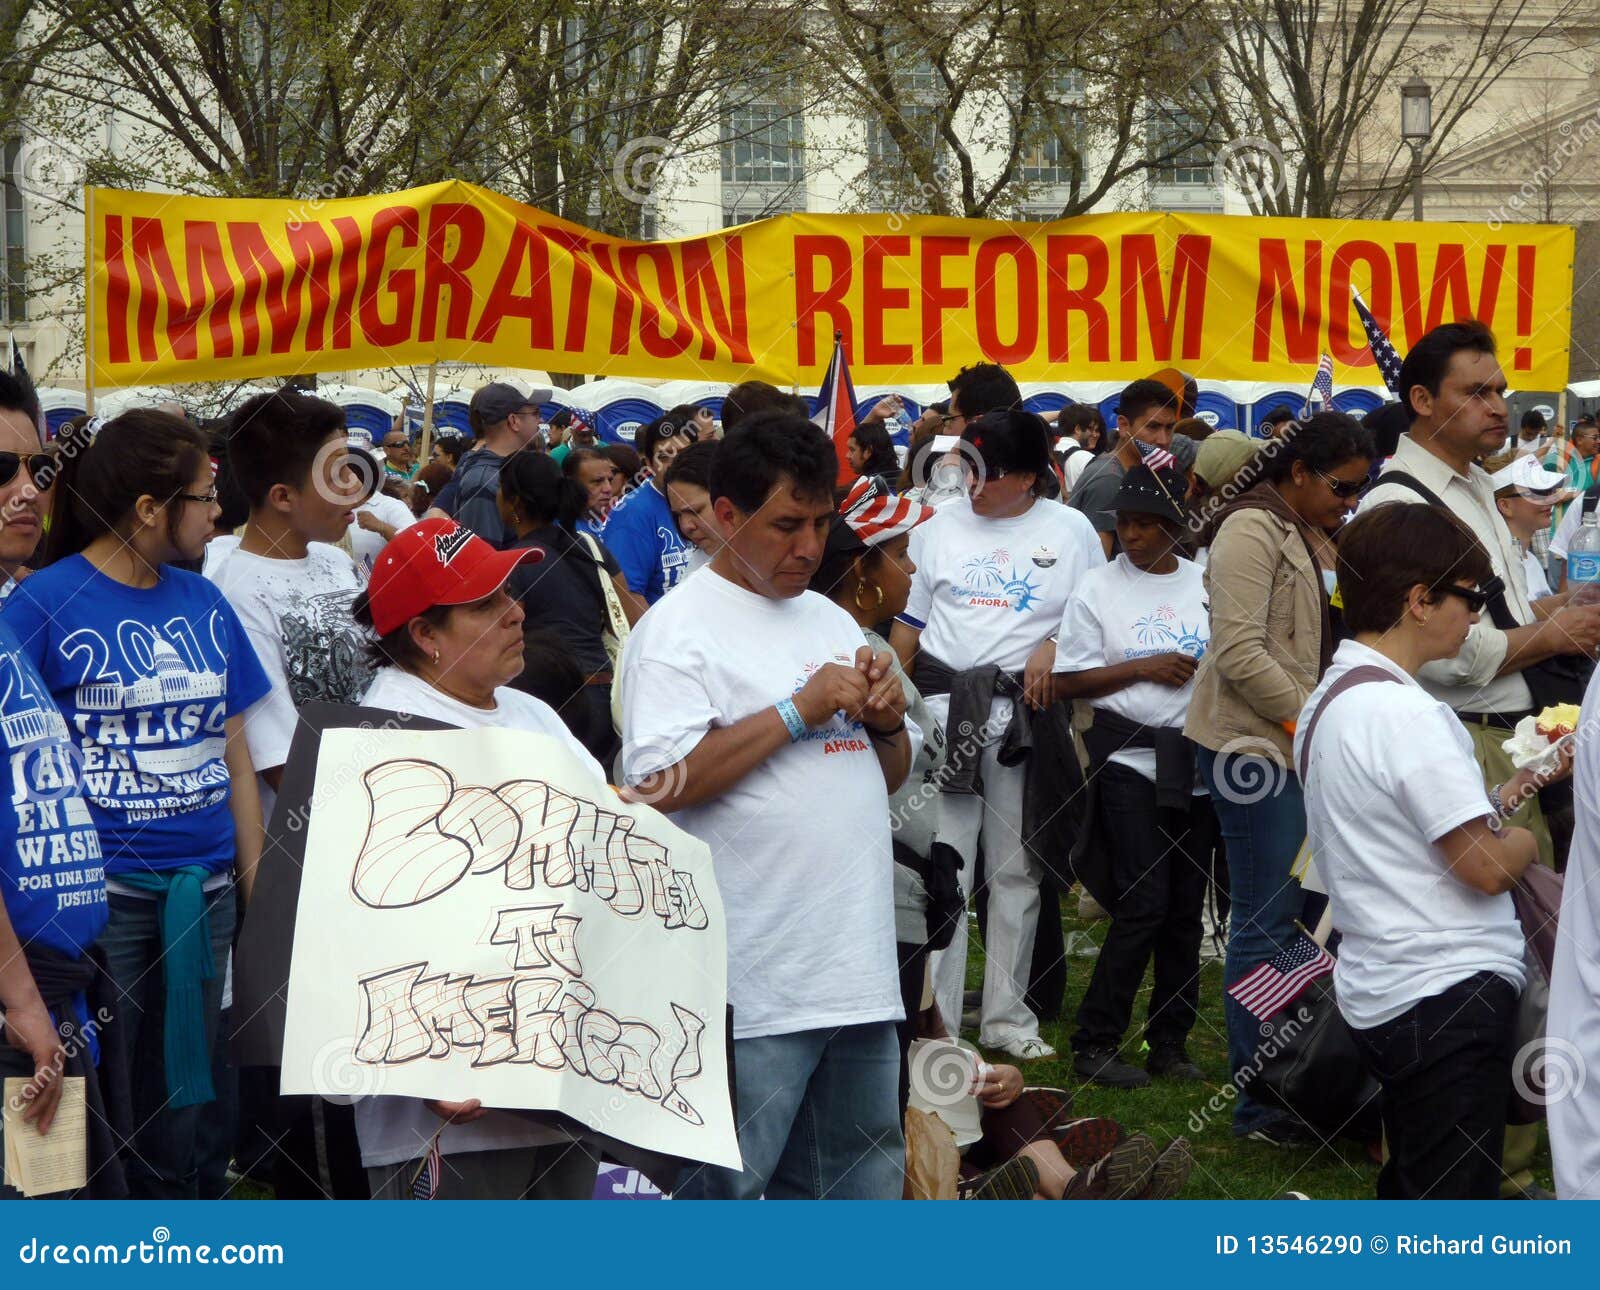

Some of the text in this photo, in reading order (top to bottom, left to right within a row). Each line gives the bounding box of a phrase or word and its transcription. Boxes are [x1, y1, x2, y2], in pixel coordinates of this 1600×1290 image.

[105, 202, 1536, 372] IMMIGRATION REFORM NOW!
[969, 598, 1009, 608] AHORA
[82, 746, 131, 771] EN
[824, 739, 868, 755] AHORA
[122, 799, 155, 809] UNA
[14, 799, 60, 834] EN
[18, 873, 52, 892] POR
[55, 869, 84, 887] UNA
[57, 890, 92, 911] JUSTA
[491, 903, 583, 977] TO
